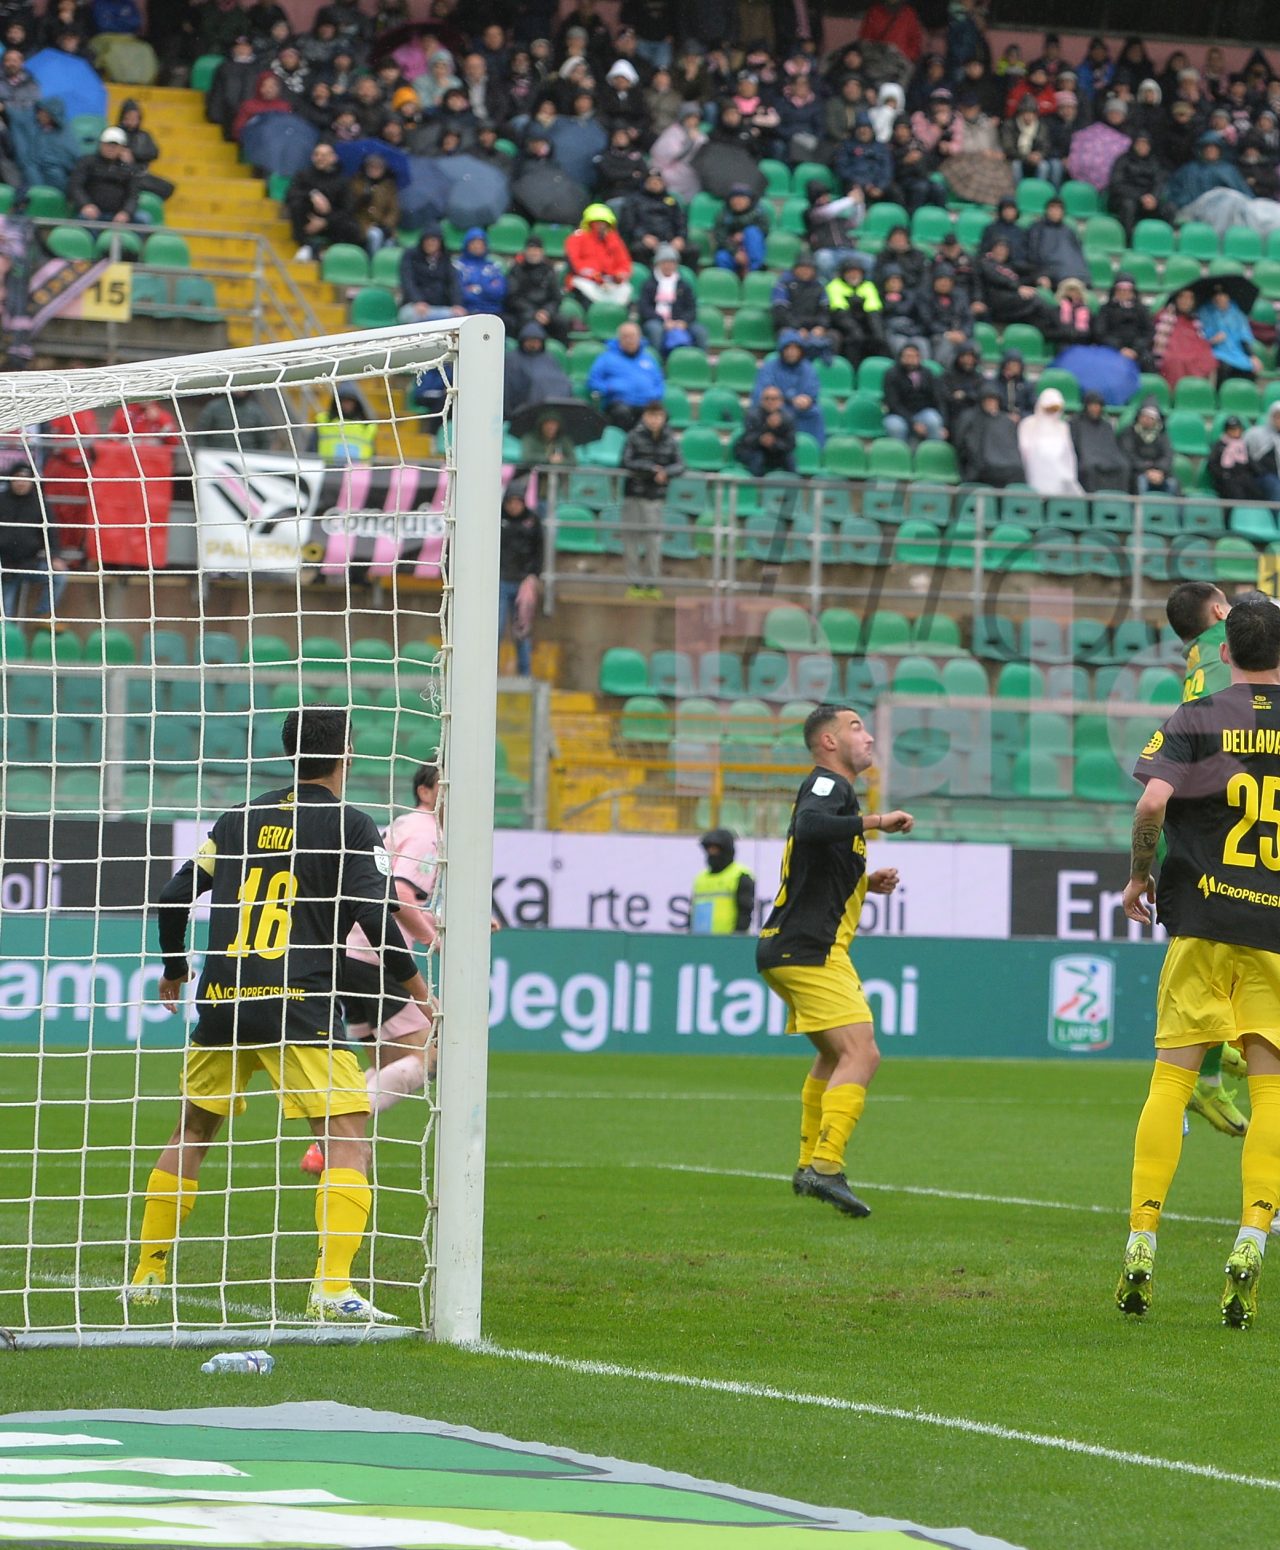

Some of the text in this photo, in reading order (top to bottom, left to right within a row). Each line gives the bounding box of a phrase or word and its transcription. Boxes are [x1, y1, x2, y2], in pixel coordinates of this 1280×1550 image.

[86, 280, 126, 306] 15
[205, 537, 325, 564] PALERMO
[257, 825, 294, 850] GERLI
[225, 867, 300, 961] 16
